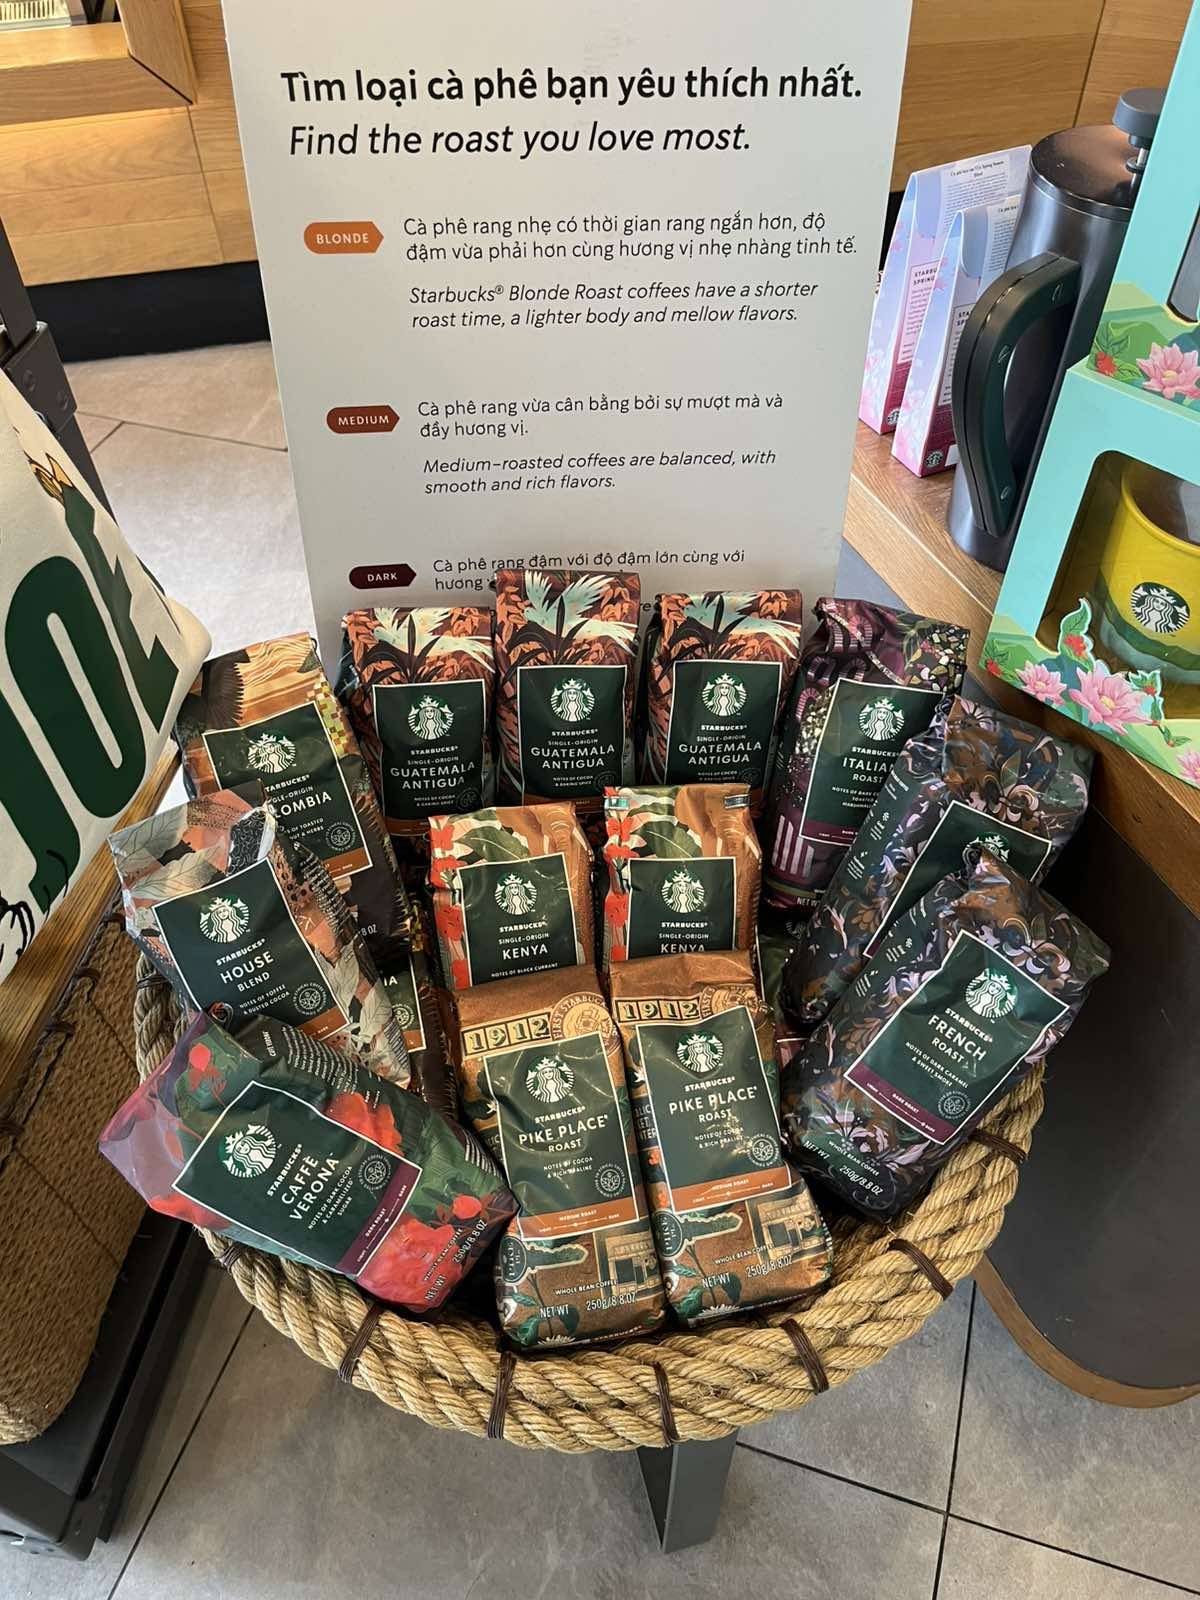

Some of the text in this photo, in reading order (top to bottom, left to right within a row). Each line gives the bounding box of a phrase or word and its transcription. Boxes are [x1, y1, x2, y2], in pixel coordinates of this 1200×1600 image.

[280, 63, 861, 107] Tìm loại cà phê bạn yêu thích nhất.
[290, 121, 749, 160] Find the roast you love most.
[403, 210, 825, 238] Cà phê rang nhẹ có thời gian rang ngắn hơn, độ
[316, 232, 370, 245] BLONDE
[406, 235, 857, 263] đậm vừa phải hơn cùng hương vị nhẹ nhàng tinh tế.
[509, 284, 569, 301] Blonde
[574, 283, 623, 300] Roast
[627, 282, 690, 299] coffees
[695, 282, 735, 298] have
[741, 285, 750, 297] a
[754, 281, 818, 297] shorter
[412, 304, 798, 328] roast time, a lighter body and mellow flavors.
[418, 393, 783, 418] Cà phê rang vừa cân bằng bởi sự mượt mà và
[338, 415, 390, 426] MEDIUM
[420, 420, 528, 440] đầy hương vị.
[567, 453, 625, 468] coffees
[630, 454, 655, 467] are
[659, 451, 736, 467] balanced,
[741, 450, 776, 464] with
[425, 474, 616, 495] smooth and rich flavors.
[433, 550, 745, 573] Cà phê rang đậm với độ đậm lớn cùng với
[367, 572, 398, 582] DARK
[435, 578, 484, 592] hương
[531, 744, 615, 758] GUATEMALA
[679, 741, 762, 754] GUATEMALA
[542, 758, 604, 769] ANTIGUA
[688, 754, 750, 765] ANTIGUA
[390, 761, 475, 778] GUATEMALA
[402, 776, 464, 790] ANTIGUA
[502, 944, 548, 960] KENYA
[661, 944, 705, 954] KENYA
[220, 951, 274, 984] HOUSE
[237, 971, 270, 992] BLEND
[270, 991, 290, 1004] COCOA
[622, 1002, 698, 1020] 1912
[469, 1017, 550, 1050] 1912
[928, 1015, 987, 1061] FRENCH
[932, 1037, 965, 1063] ROAST
[669, 1097, 704, 1115] PIKE
[698, 1108, 732, 1123] ROAST
[518, 1129, 553, 1145] PIKE
[548, 1138, 582, 1153] ROAST
[281, 1155, 318, 1204] CAFFÈ
[337, 1166, 353, 1188] COCOA
[289, 1158, 340, 1220] VERONA
[871, 1183, 884, 1196] OZ
